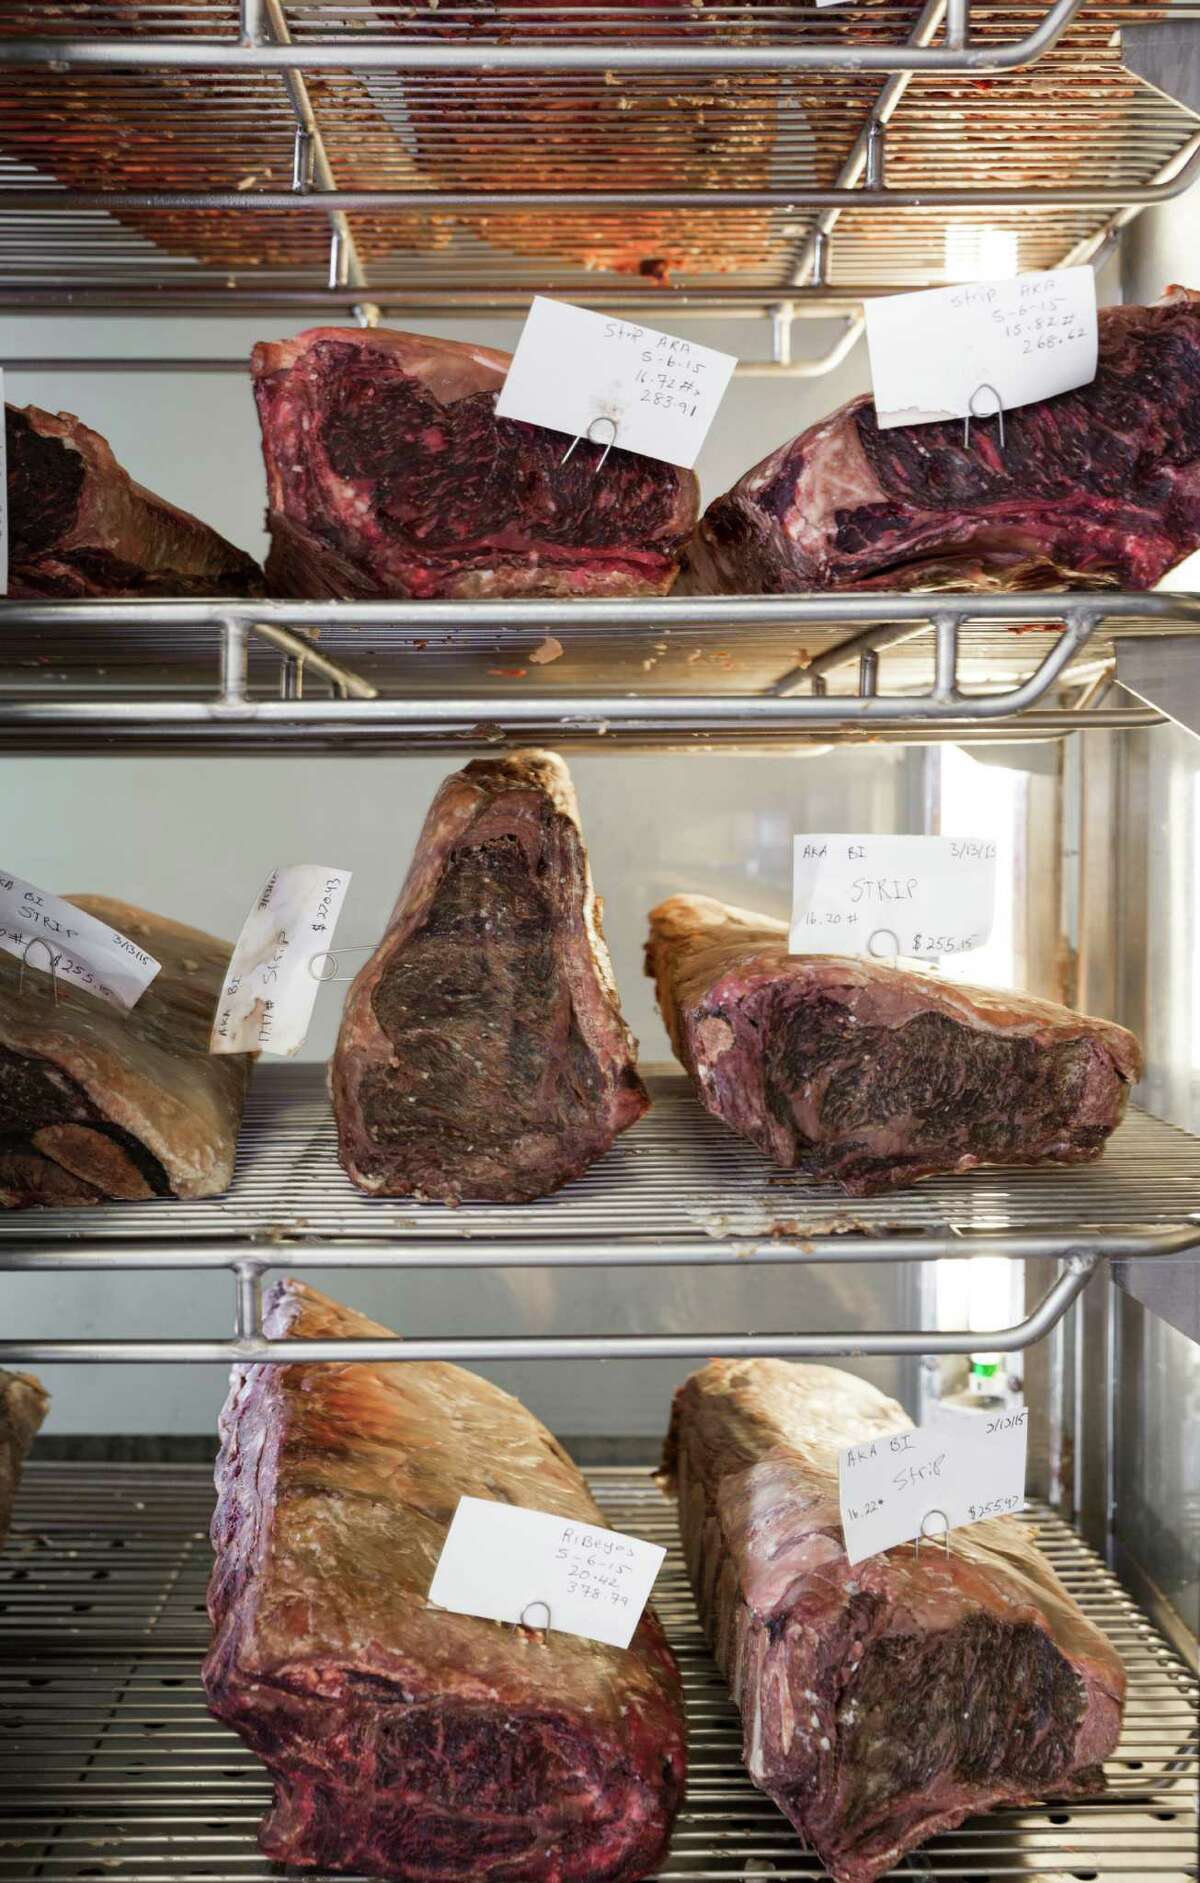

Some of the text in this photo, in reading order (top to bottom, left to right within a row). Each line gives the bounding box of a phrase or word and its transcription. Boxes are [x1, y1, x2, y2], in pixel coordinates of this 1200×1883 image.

[802, 843, 829, 859] AKA
[848, 846, 868, 860] BI
[850, 878, 919, 904] STRIP
[847, 1444, 878, 1467] AKA
[888, 1434, 917, 1453] BI
[567, 1565, 621, 1588] 20.42
